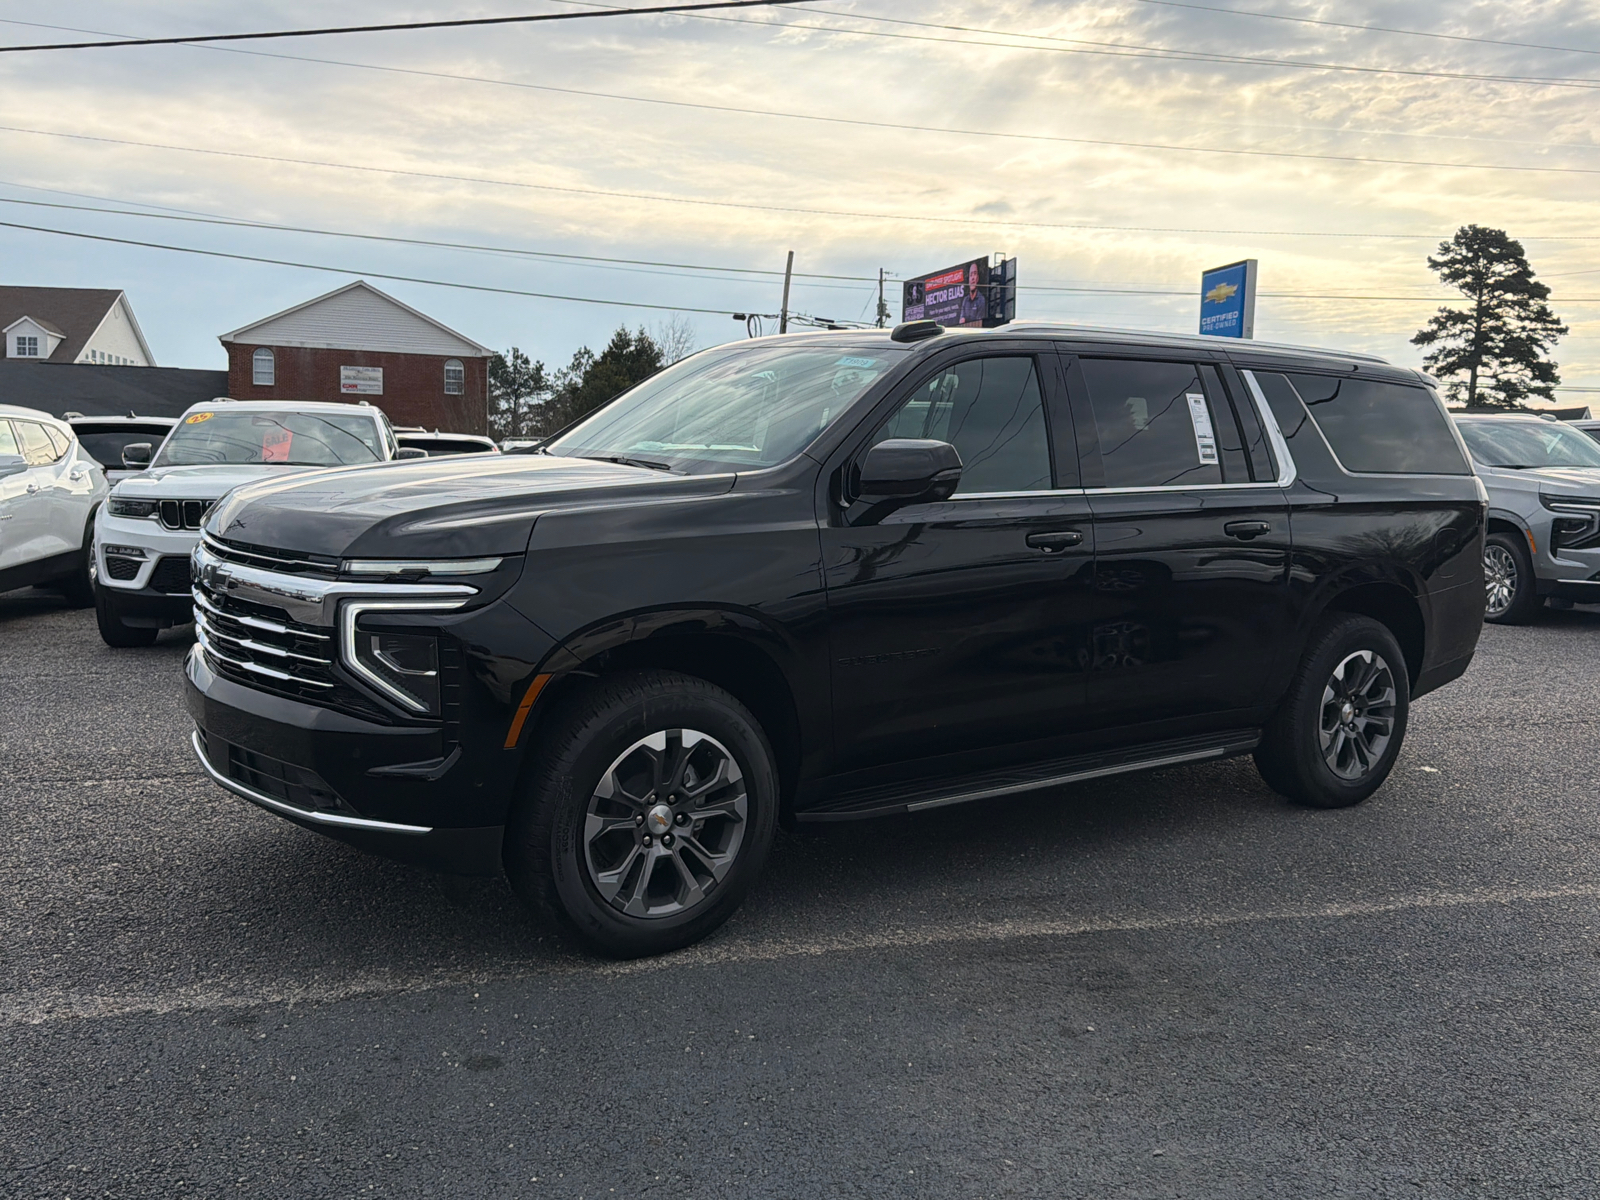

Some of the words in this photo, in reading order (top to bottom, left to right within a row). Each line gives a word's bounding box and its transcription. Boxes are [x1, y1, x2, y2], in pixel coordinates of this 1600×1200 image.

[925, 289, 948, 306] HECTOR
[948, 285, 964, 301] ELIAS
[1202, 311, 1239, 325] CERTIFIED
[1203, 319, 1237, 331] PRE-OWNED
